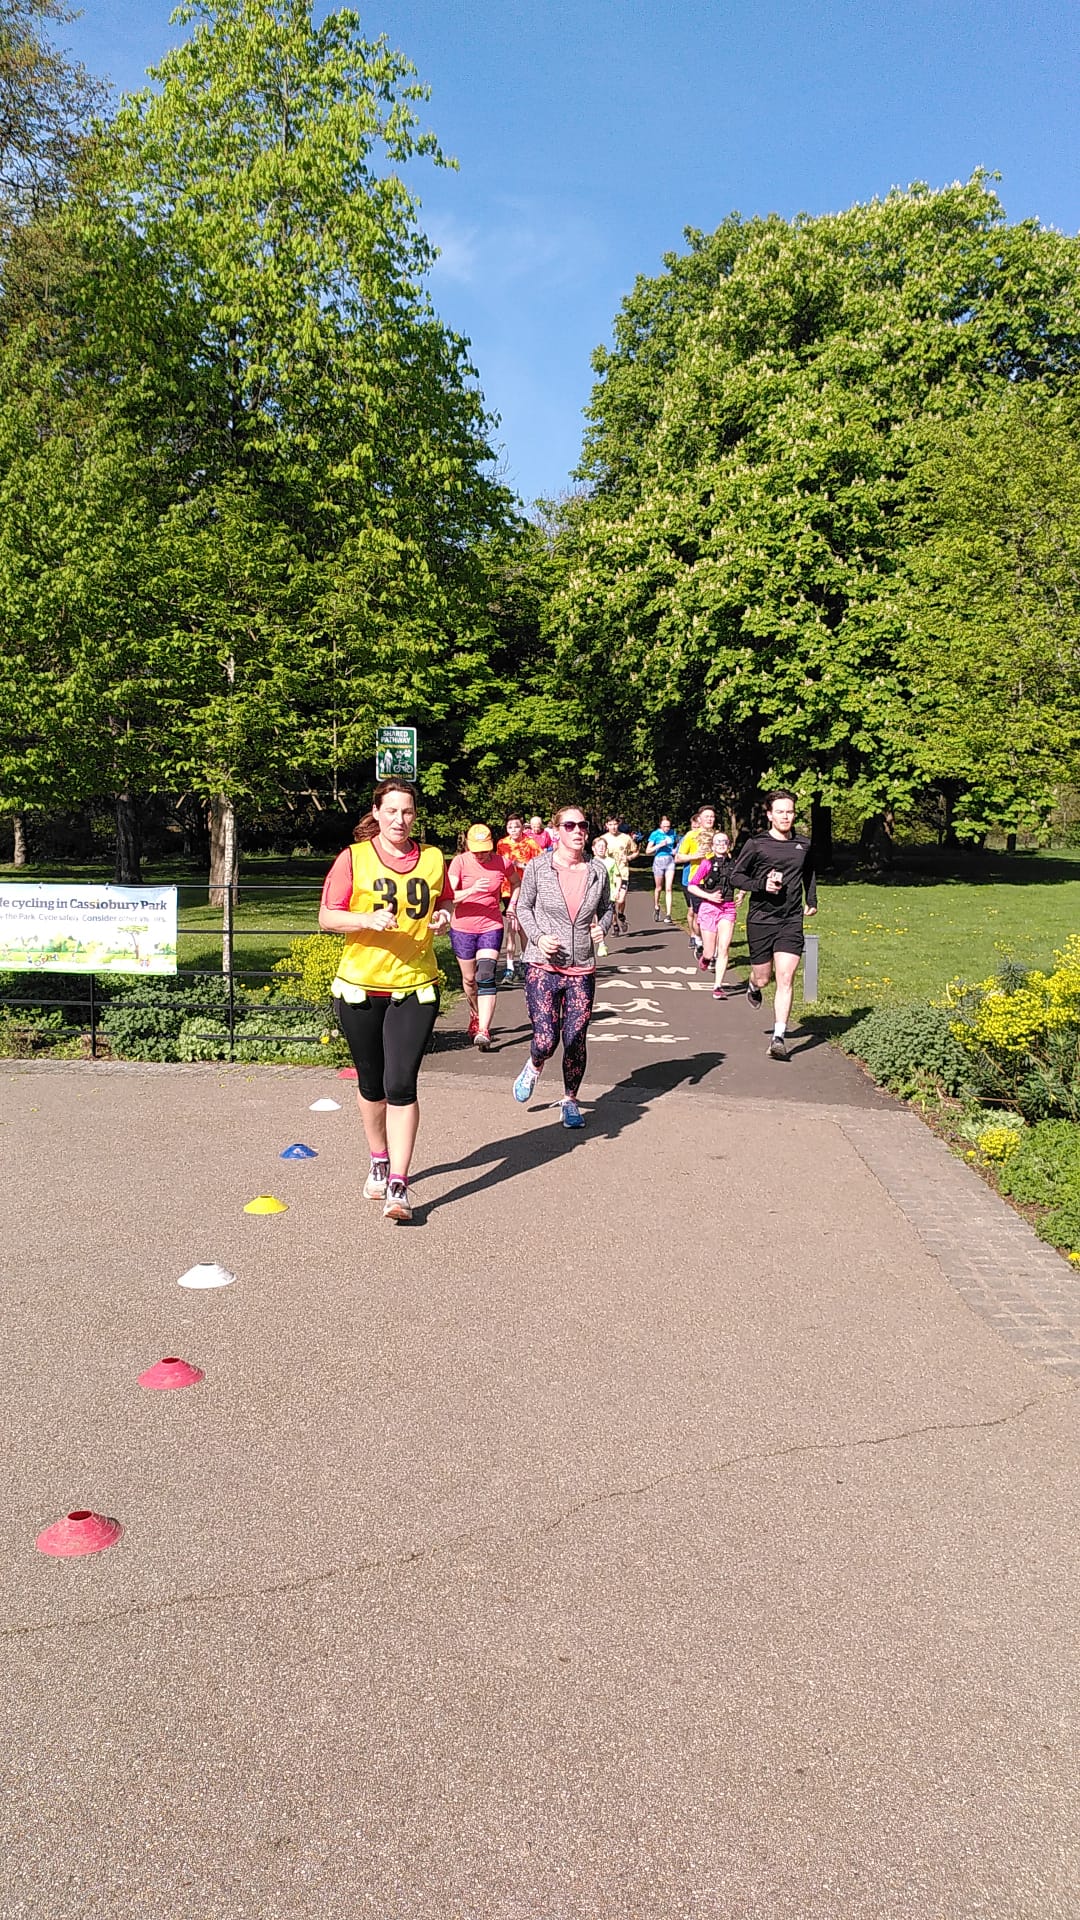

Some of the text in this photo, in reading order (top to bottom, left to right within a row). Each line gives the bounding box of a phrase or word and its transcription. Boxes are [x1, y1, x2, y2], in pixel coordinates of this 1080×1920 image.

[0, 897, 167, 912] fe cycling in Cassiobury Park
[373, 877, 430, 920] 39
[82, 914, 117, 922] Consider
[617, 965, 697, 975] OW
[596, 979, 730, 991] ARE
